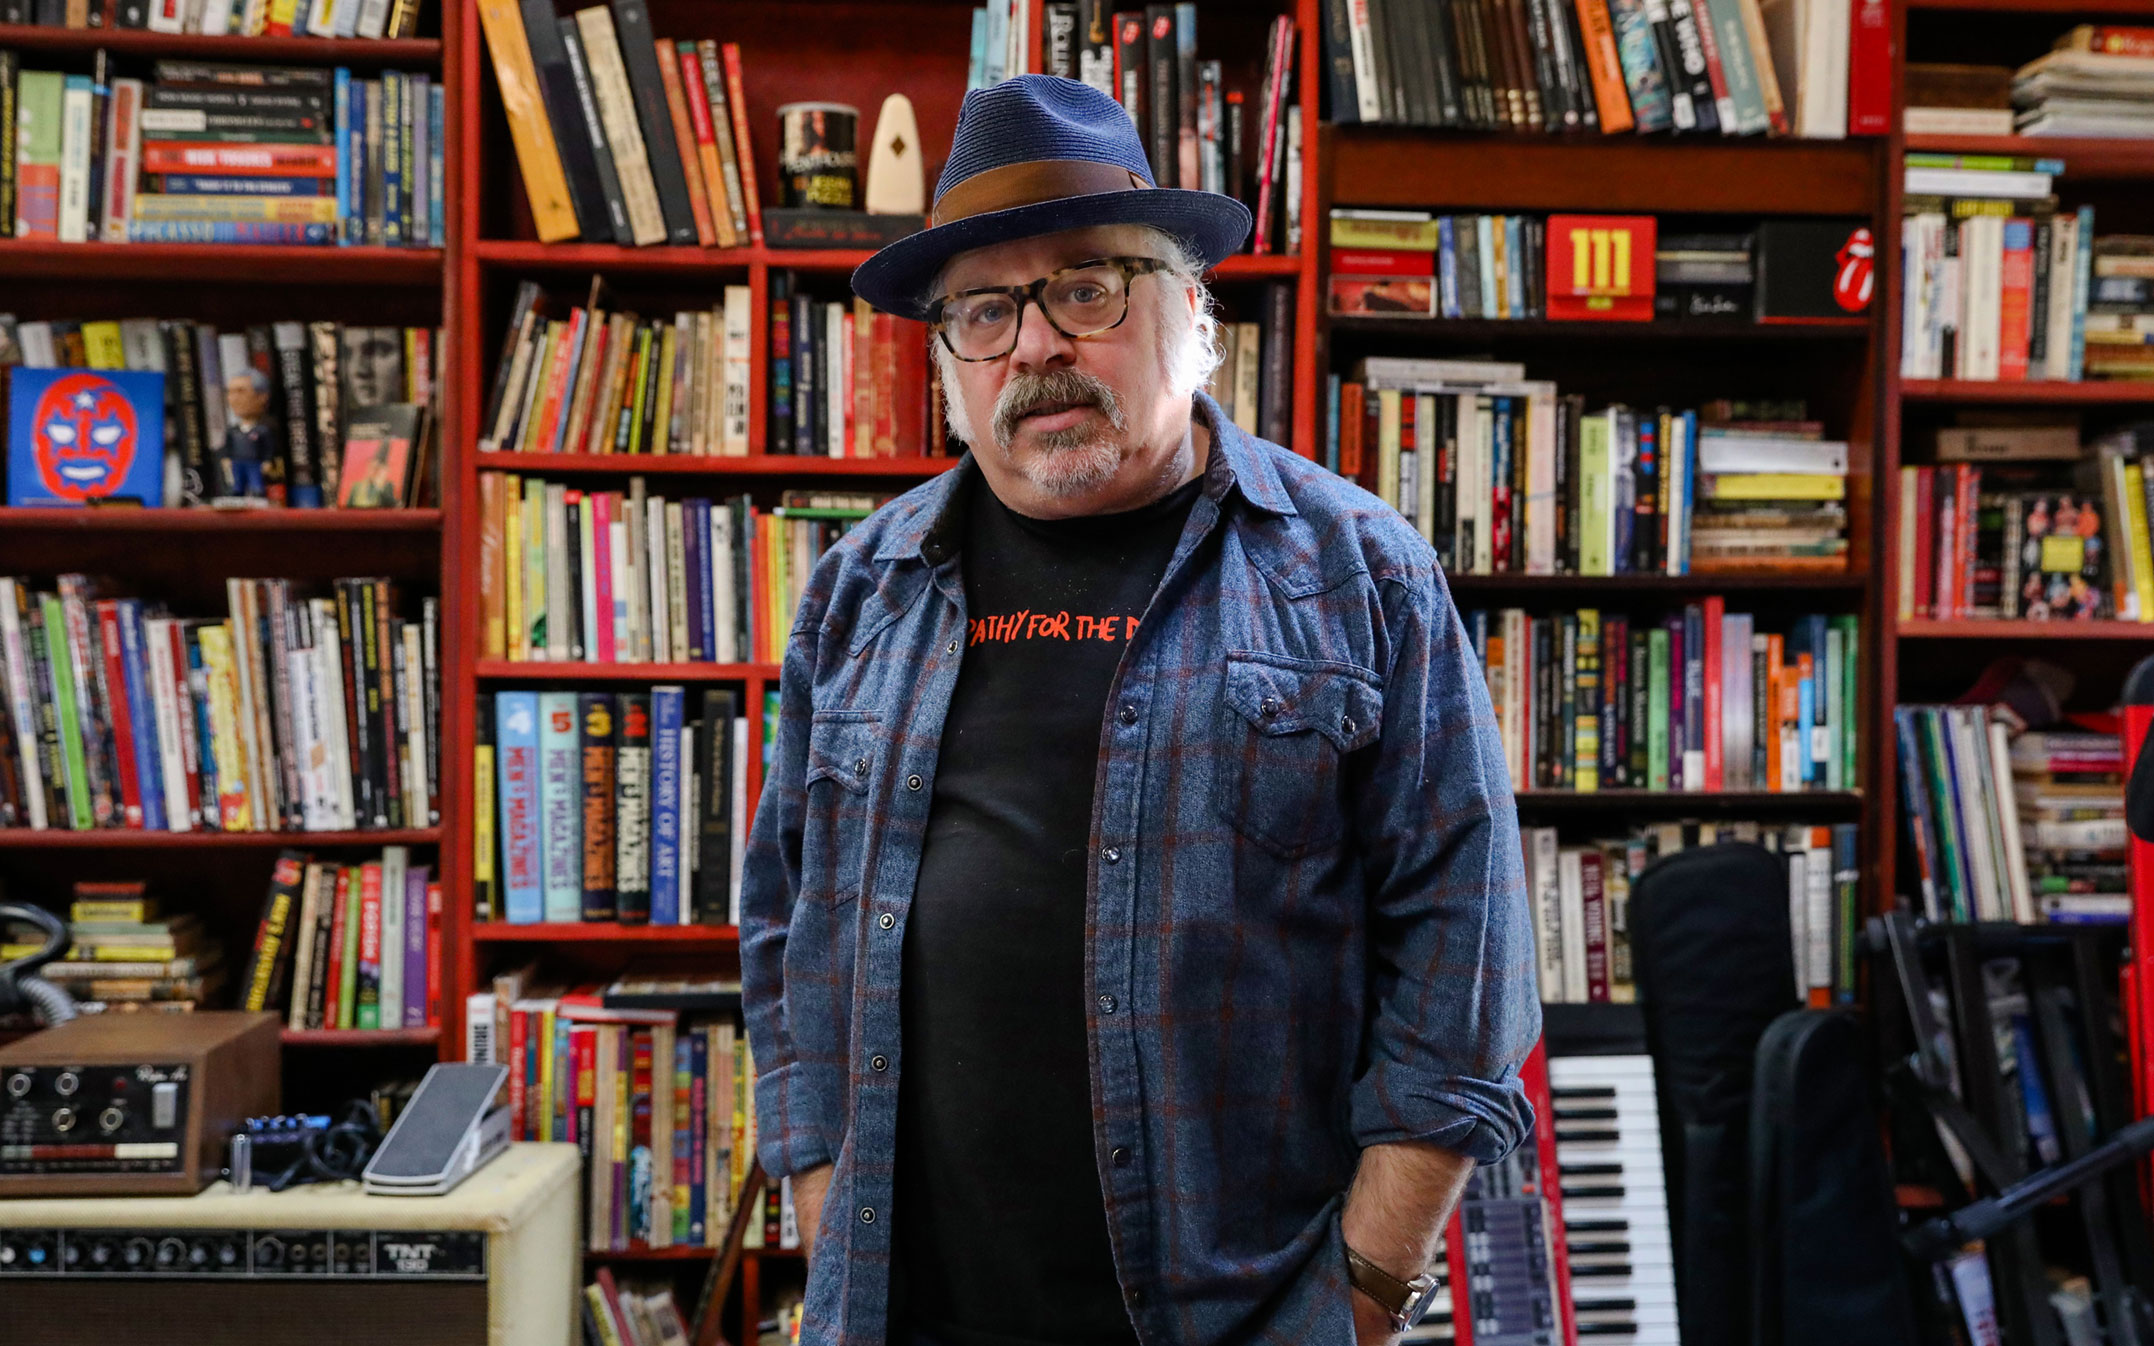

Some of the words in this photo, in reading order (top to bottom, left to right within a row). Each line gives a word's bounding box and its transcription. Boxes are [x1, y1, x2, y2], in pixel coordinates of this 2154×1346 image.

[1026, 610, 1070, 642] FOR
[1075, 615, 1120, 642] THE
[658, 728, 677, 810] HISTORY
[658, 811, 676, 835] OF
[657, 842, 675, 877] ART
[383, 1243, 438, 1260] TNT
